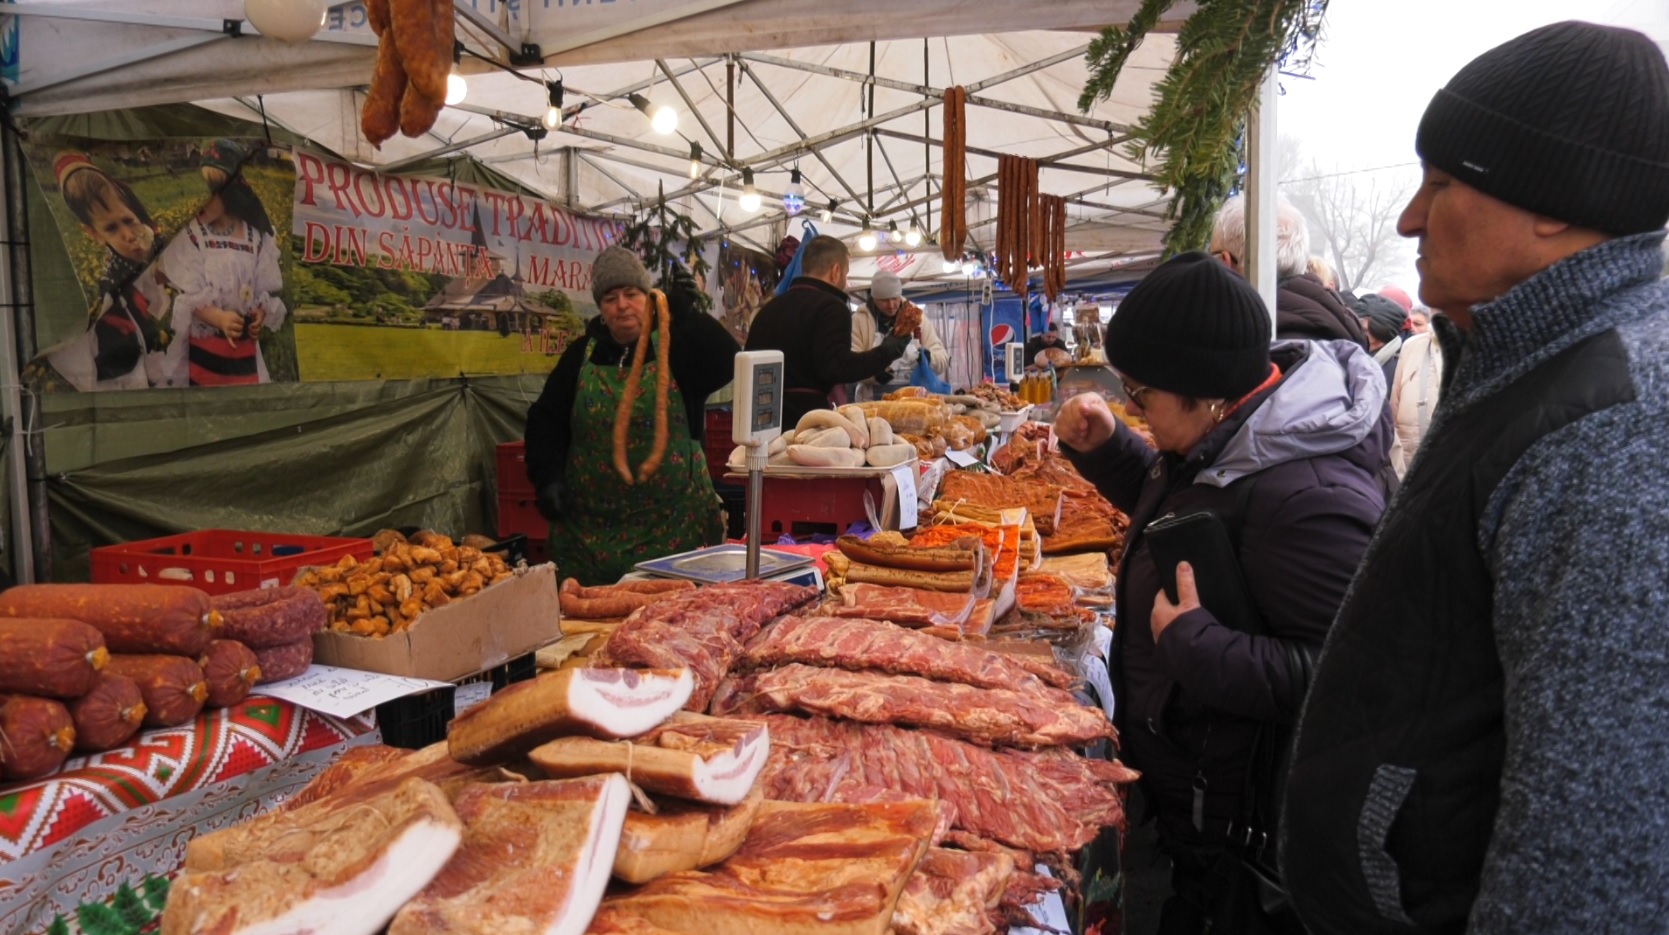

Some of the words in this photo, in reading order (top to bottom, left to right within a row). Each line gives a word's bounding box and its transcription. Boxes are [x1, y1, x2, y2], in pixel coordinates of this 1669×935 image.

[297, 151, 477, 233] PRODUSE
[484, 190, 624, 253] TRADITIO
[301, 220, 368, 268] DIN
